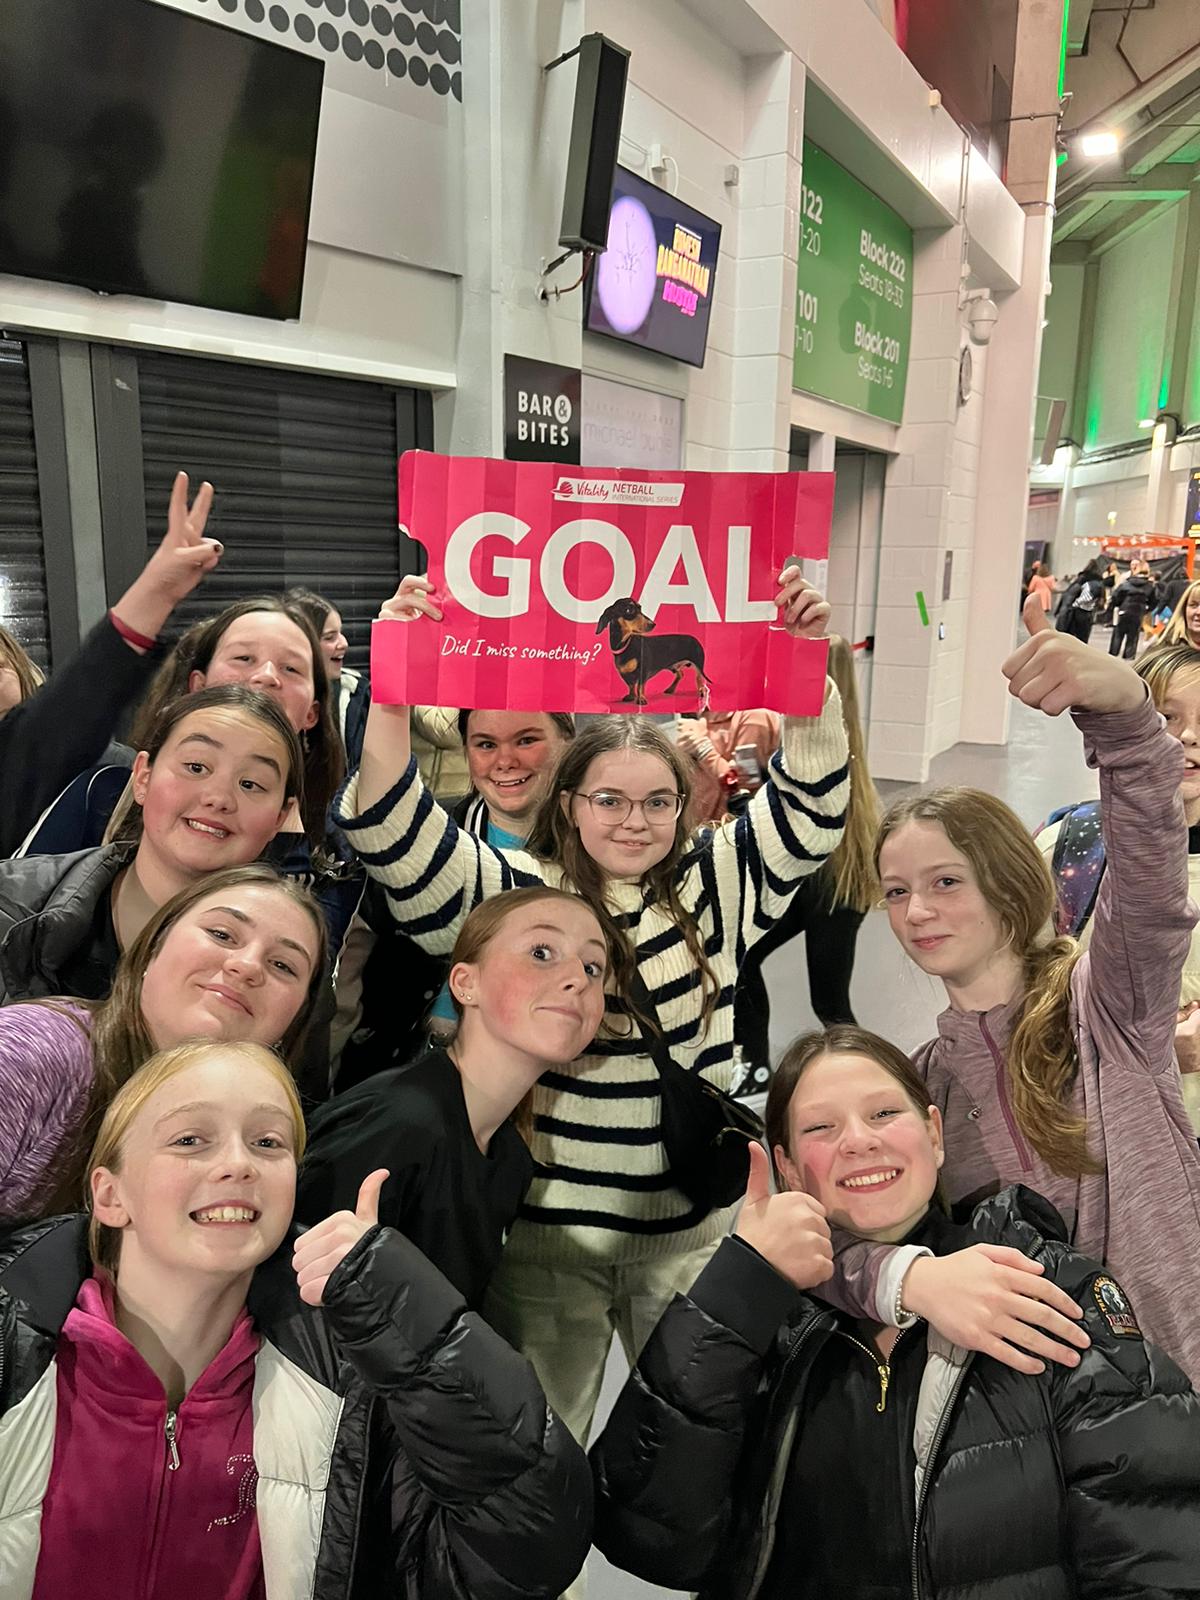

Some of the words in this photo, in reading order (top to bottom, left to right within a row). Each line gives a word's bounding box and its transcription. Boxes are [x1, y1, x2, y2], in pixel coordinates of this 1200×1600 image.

[802, 185, 823, 224] 122
[860, 229, 888, 271] Block
[889, 250, 905, 282] 222
[859, 264, 884, 297] Seats
[798, 289, 818, 324] 101
[855, 321, 883, 356] Block
[884, 336, 900, 364] 201
[858, 355, 882, 385] Seats
[518, 390, 553, 417] BAR
[517, 419, 569, 447] BITES
[576, 480, 609, 501] Vitality
[612, 482, 654, 495] NETBALL
[444, 511, 778, 623] GOAL
[441, 635, 471, 656] Did
[472, 639, 485, 657] I
[486, 643, 517, 658] miss
[520, 643, 602, 665] something?
